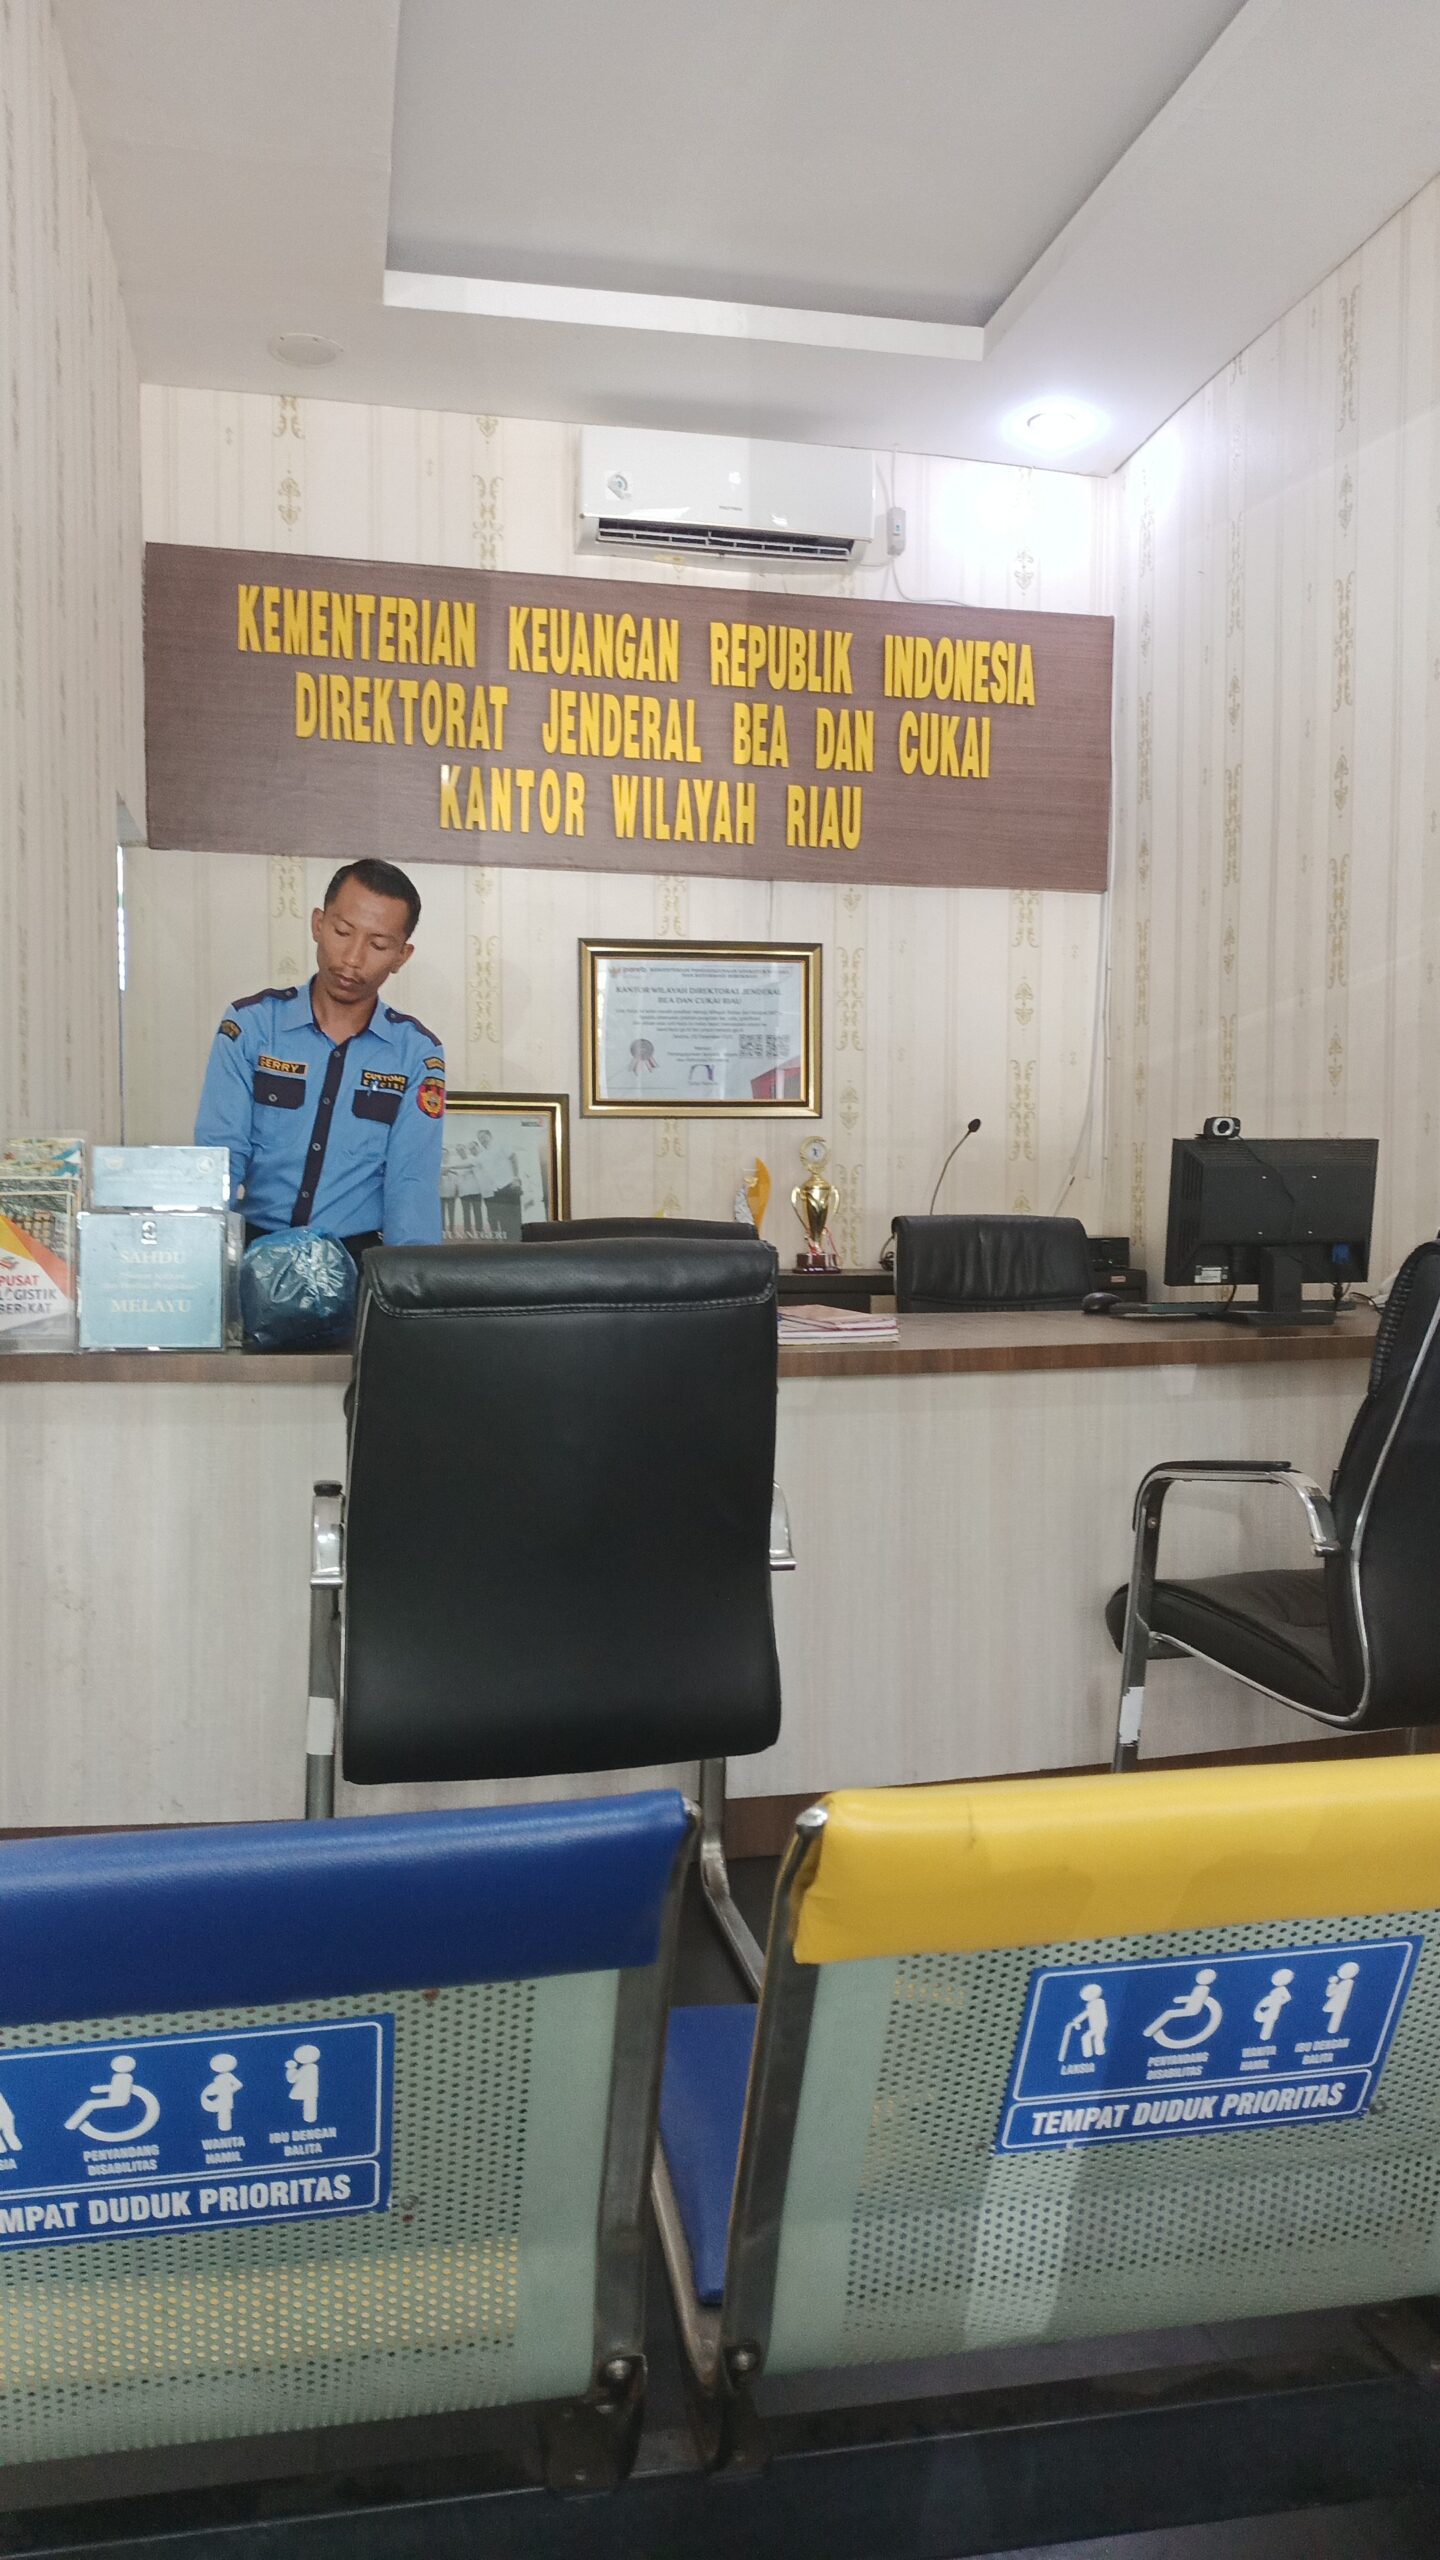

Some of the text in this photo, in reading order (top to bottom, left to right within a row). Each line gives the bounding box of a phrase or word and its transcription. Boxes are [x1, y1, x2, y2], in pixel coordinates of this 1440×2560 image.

[236, 583, 1037, 708] KEMENTERIAN KEUANGAN REPUBLIK INDONESIA
[294, 670, 992, 781] DIREKTORAT JENDERAL BEA DAN CUKAI
[439, 765, 864, 852] KANTOR WILAYAH RIAU
[363, 1079, 404, 1092] ECISE
[0, 1275, 40, 1286] PUSAT
[111, 1298, 192, 1313] MELAYU
[1032, 2082, 1346, 2136] TEMPAT DUDUK PRIORITAS
[291, 2126, 337, 2142] DENGAN
[201, 2136, 246, 2151] WANITA
[283, 2142, 323, 2157] BALITA
[83, 2144, 160, 2162] PENYANDANG
[87, 2159, 158, 2176] DISABILITAS
[88, 2191, 192, 2226] DUDUK
[200, 2174, 352, 2214] PRIORITAS
